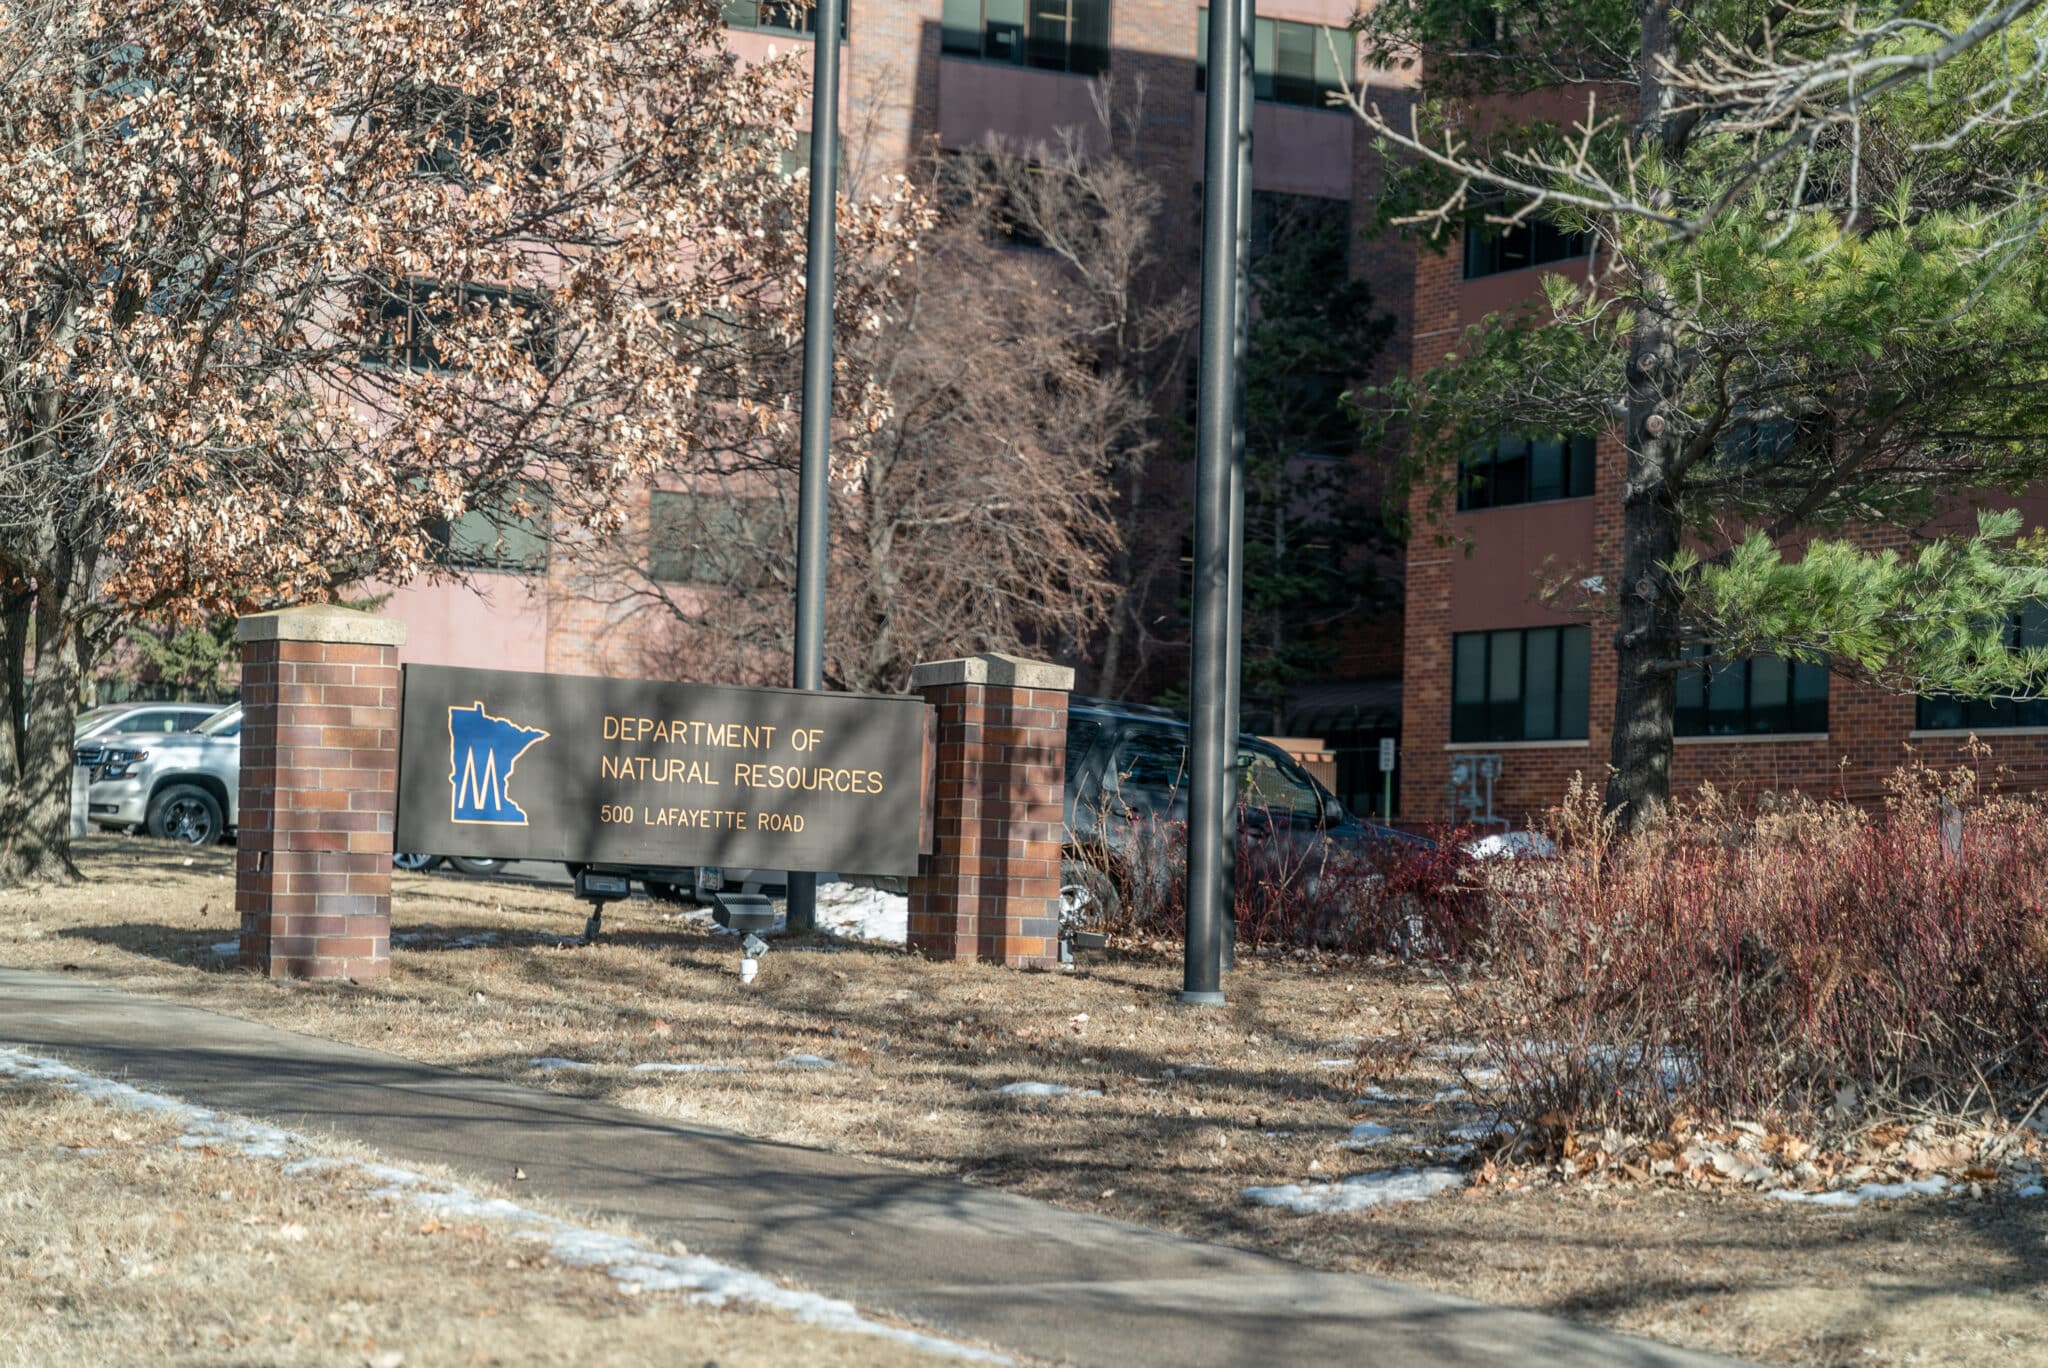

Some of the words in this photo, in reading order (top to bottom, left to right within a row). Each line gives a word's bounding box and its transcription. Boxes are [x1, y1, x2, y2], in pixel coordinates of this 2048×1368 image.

[602, 715, 777, 750] DEPARTMENT
[791, 728, 825, 752] OF
[601, 755, 719, 785] NATURAL
[734, 763, 884, 794] RESOURCES
[600, 805, 634, 824] 500
[644, 807, 747, 830] LAFAYETTE
[757, 812, 805, 833] ROAD
